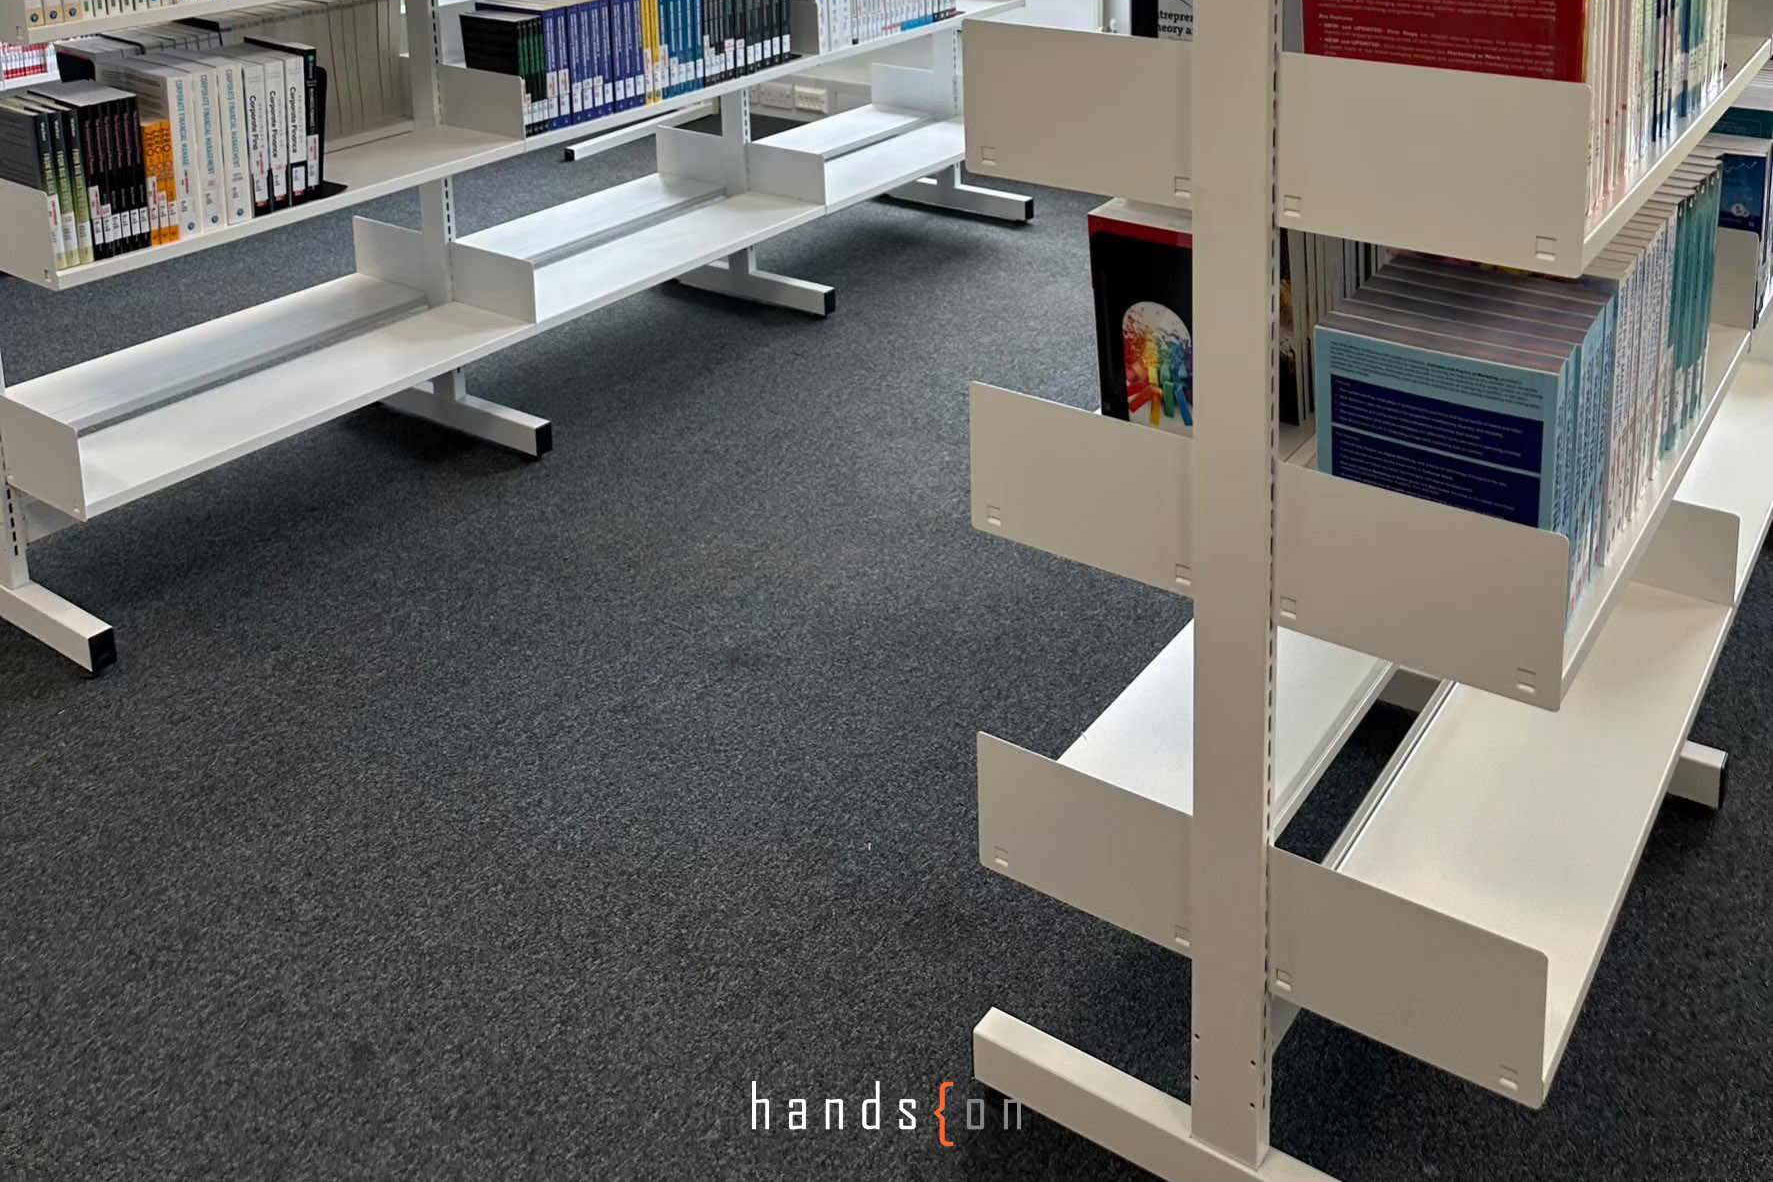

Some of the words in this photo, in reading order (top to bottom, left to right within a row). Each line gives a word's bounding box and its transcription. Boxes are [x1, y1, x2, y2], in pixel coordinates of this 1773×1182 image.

[249, 95, 258, 132] Corporate
[269, 91, 277, 127] Corporate
[289, 87, 297, 123] Corporate
[180, 143, 189, 166] MANAGE
[271, 129, 279, 158] Finance
